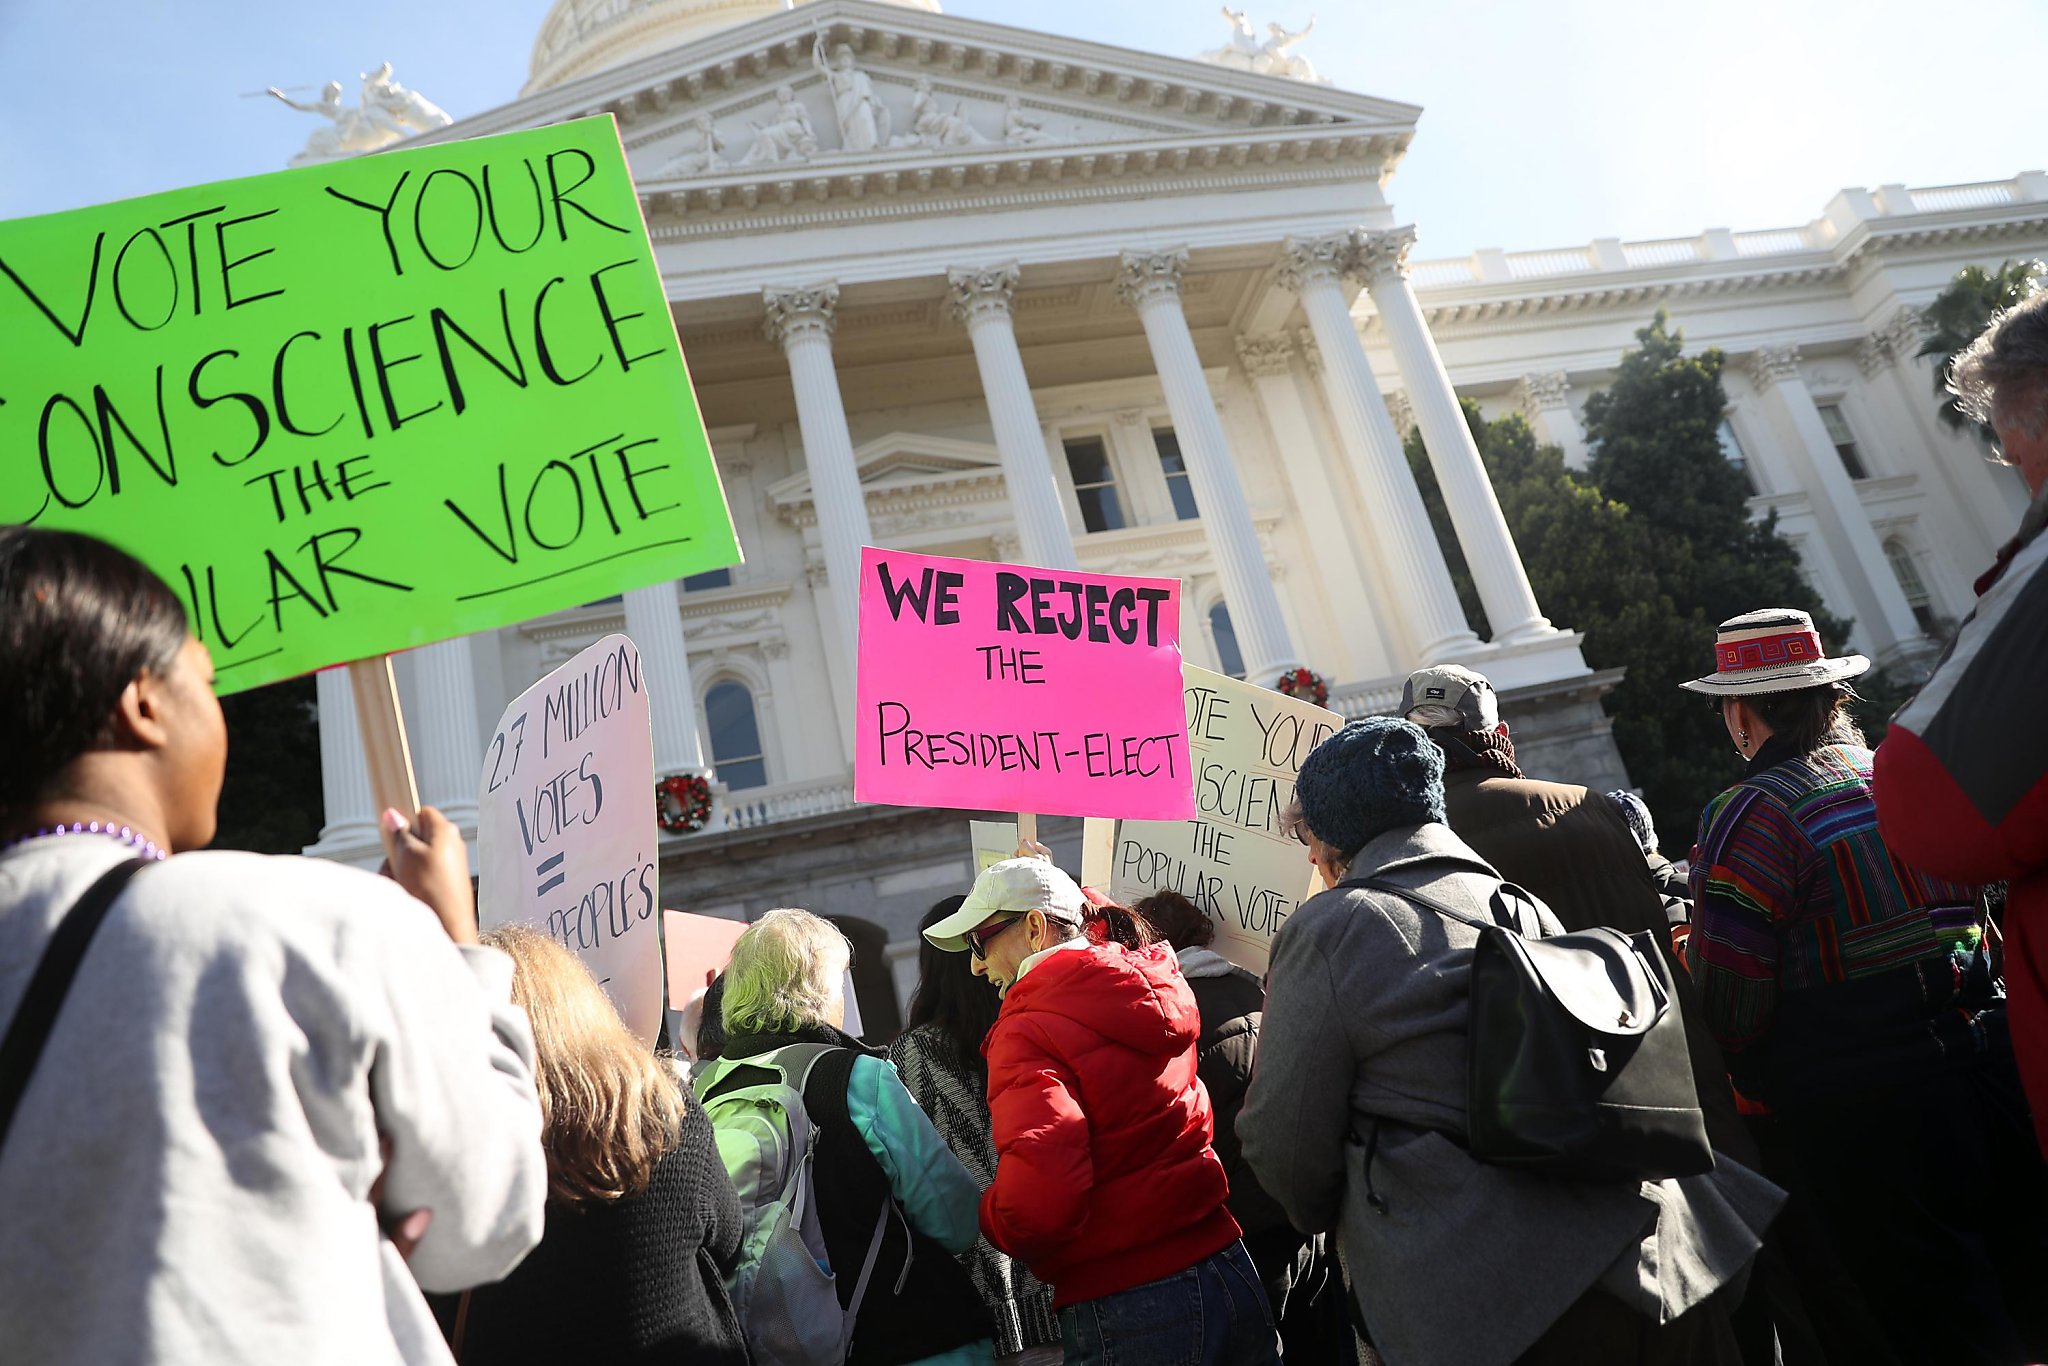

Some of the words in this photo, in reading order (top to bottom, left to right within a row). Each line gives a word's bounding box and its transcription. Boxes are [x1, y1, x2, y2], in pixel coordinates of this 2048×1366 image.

[0, 206, 286, 347] VOTE
[325, 148, 631, 276] YOUR
[0, 258, 667, 526] ONSCIENCE
[244, 454, 391, 523] THE
[444, 433, 681, 564] VOTE
[876, 561, 964, 626] WE
[995, 571, 1171, 648] REJECT
[975, 645, 1046, 684] THE
[488, 711, 528, 794] 2.7
[543, 644, 639, 760] MILLION
[1185, 687, 1230, 741] OTE
[515, 751, 604, 856] VOTES
[1195, 757, 1299, 839] SCIEN
[1122, 840, 1225, 921] POPULAR
[1187, 820, 1235, 866] THE
[546, 852, 655, 951] PEOPLE'S
